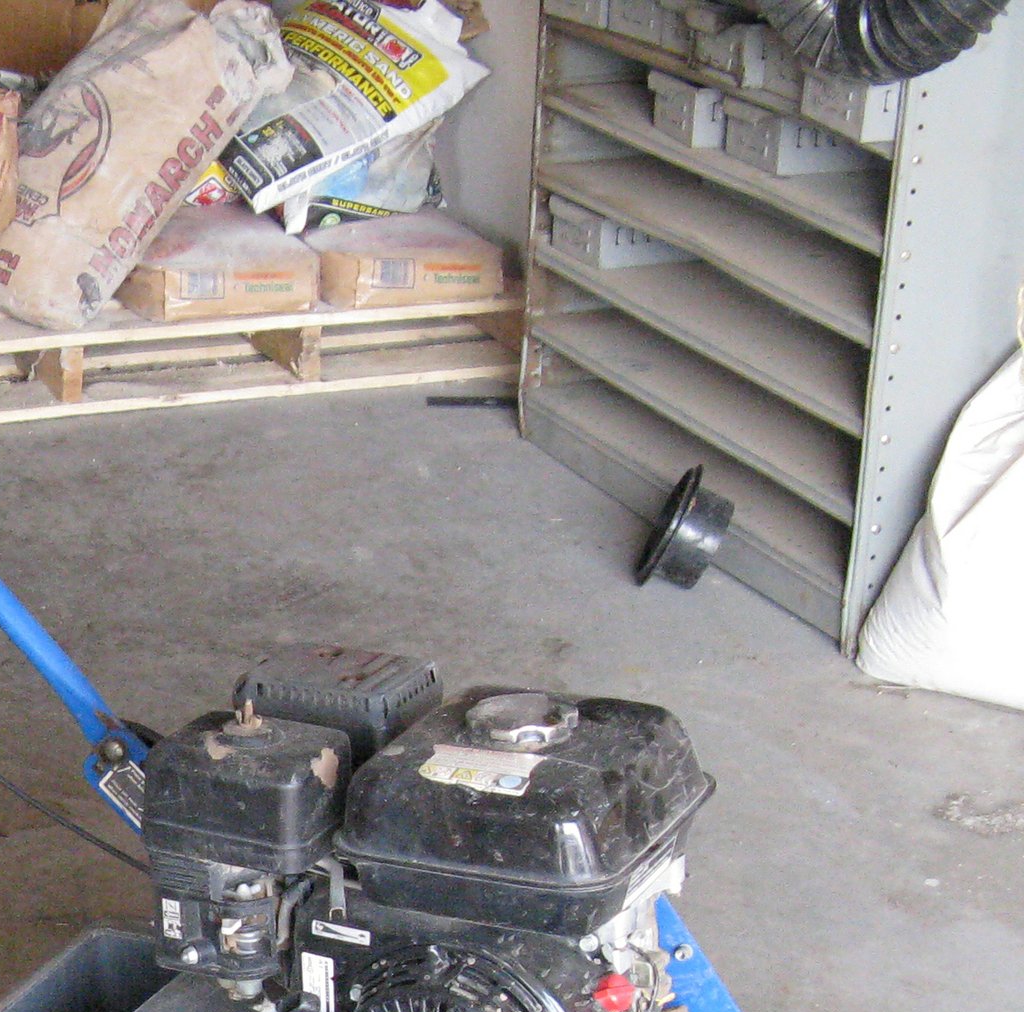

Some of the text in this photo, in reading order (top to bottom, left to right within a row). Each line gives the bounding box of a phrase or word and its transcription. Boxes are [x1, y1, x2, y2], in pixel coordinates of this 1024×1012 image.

[282, 31, 394, 118] PERFORMANCE
[364, 51, 413, 99] SAND
[87, 110, 225, 285] MONARCH
